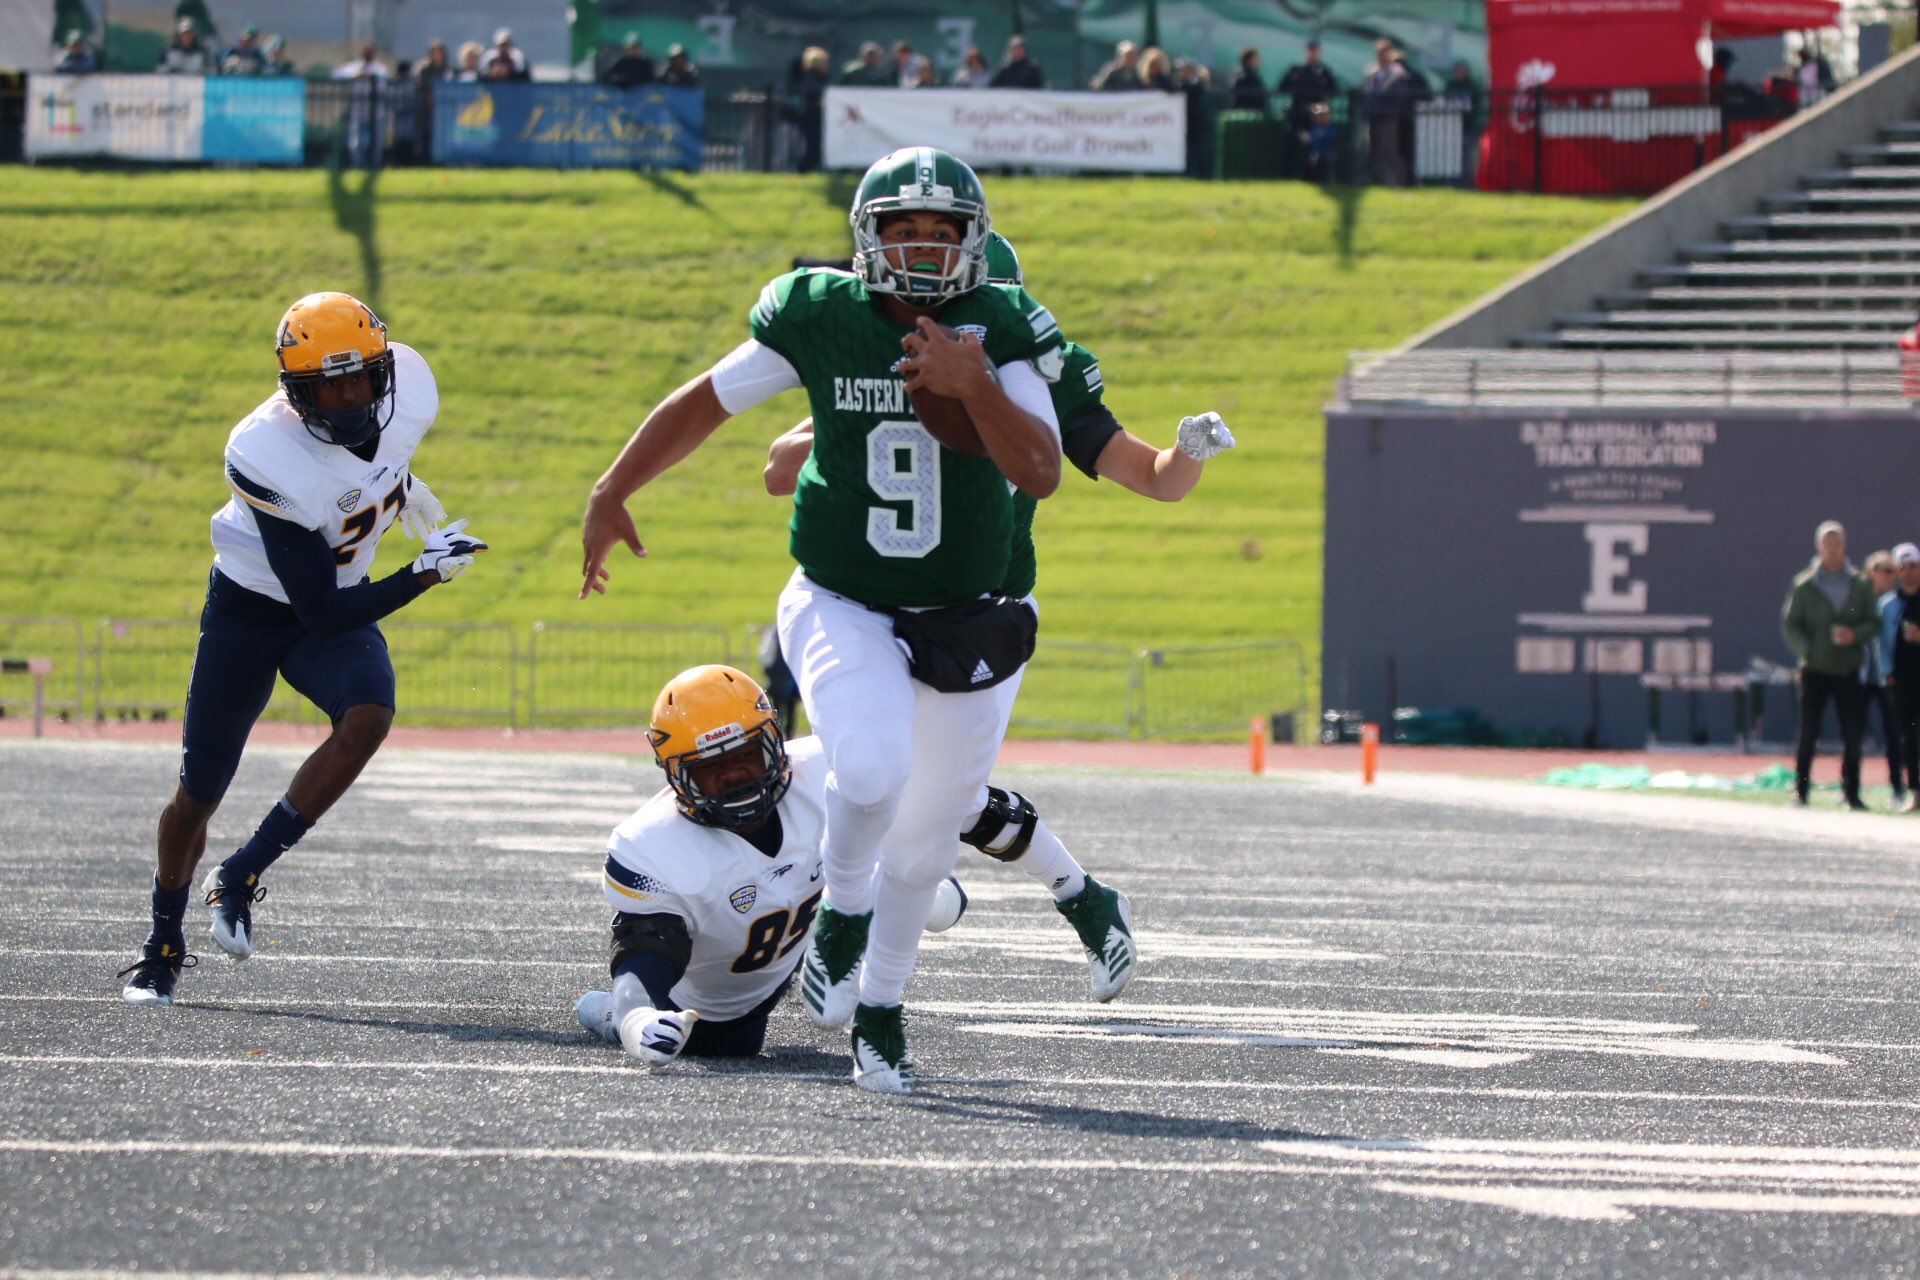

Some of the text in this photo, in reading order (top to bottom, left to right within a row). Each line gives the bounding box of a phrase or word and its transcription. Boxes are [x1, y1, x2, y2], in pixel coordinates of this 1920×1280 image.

[921, 184, 933, 197] E
[834, 377, 904, 413] EASTERN
[866, 420, 942, 559] 9
[1582, 523, 1649, 613] E
[705, 726, 731, 742] Riddell
